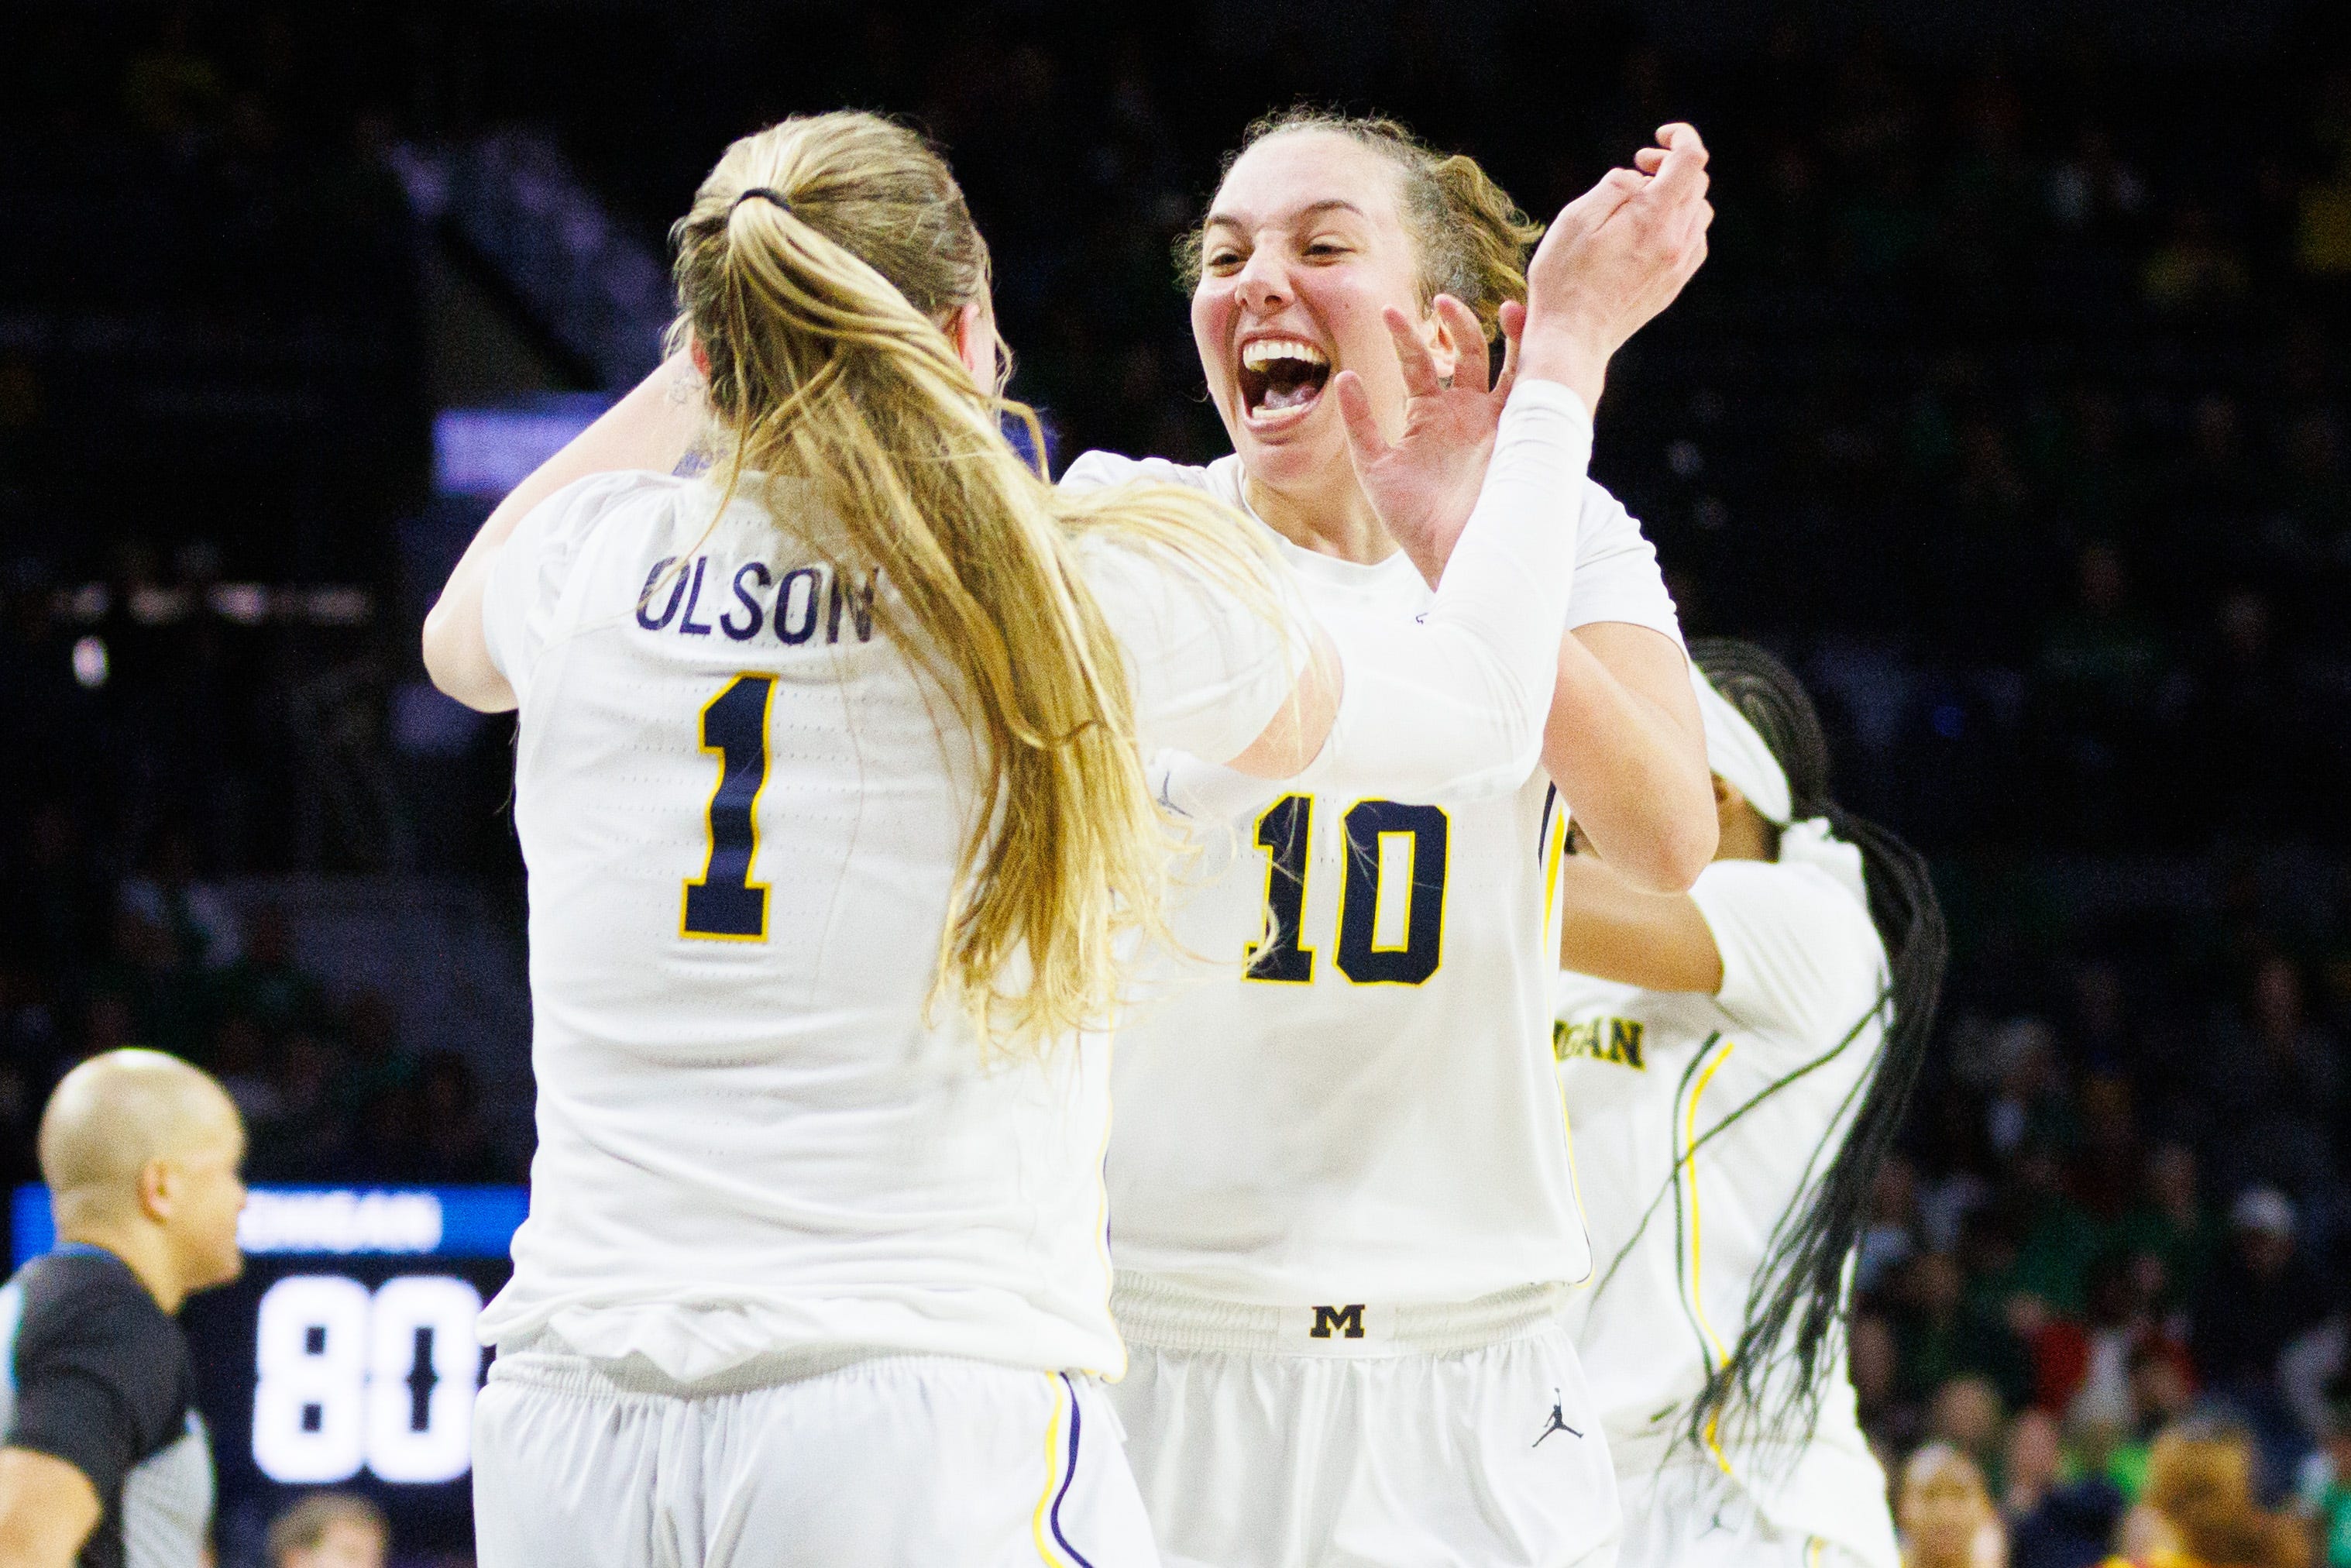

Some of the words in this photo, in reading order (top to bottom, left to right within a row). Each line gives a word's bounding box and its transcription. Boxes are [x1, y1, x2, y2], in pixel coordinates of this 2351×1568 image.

[635, 539, 879, 646] OLSON
[678, 670, 780, 944] 1
[1241, 792, 1452, 987] 10
[253, 1273, 484, 1485] 80
[1309, 1304, 1366, 1339] M
